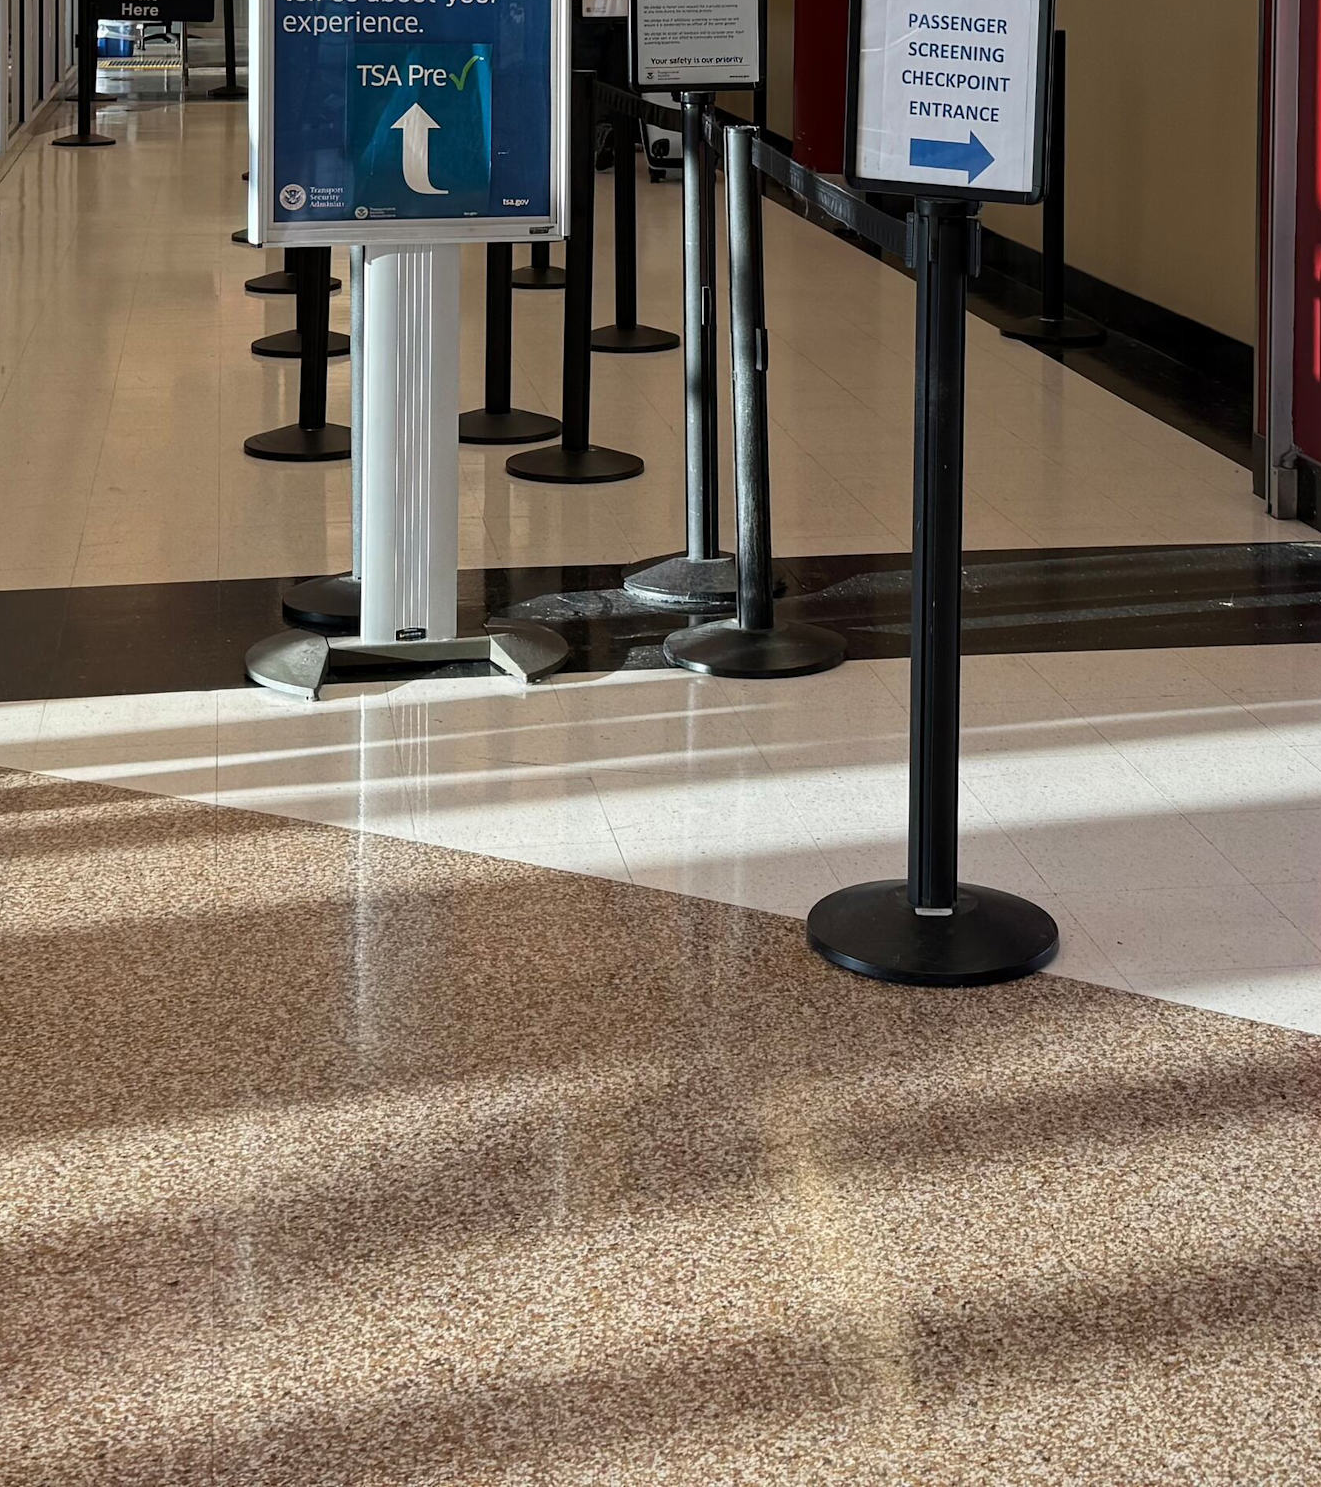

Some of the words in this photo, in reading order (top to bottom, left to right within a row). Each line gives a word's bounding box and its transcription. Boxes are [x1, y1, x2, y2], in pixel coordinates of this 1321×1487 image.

[122, 3, 159, 16] Here
[282, 12, 424, 36] experience.
[909, 13, 1007, 34] PASSENGER
[669, 57, 691, 65] safety
[715, 56, 744, 65] priority
[908, 42, 1004, 63] SCREENING
[357, 64, 402, 87] TSA
[408, 65, 447, 87] Pre
[902, 70, 1010, 92] CHECKPOINT
[910, 101, 999, 122] ENTRANCE
[310, 186, 343, 195] Transport
[310, 194, 339, 202] Security
[502, 198, 529, 207] tsa.gov
